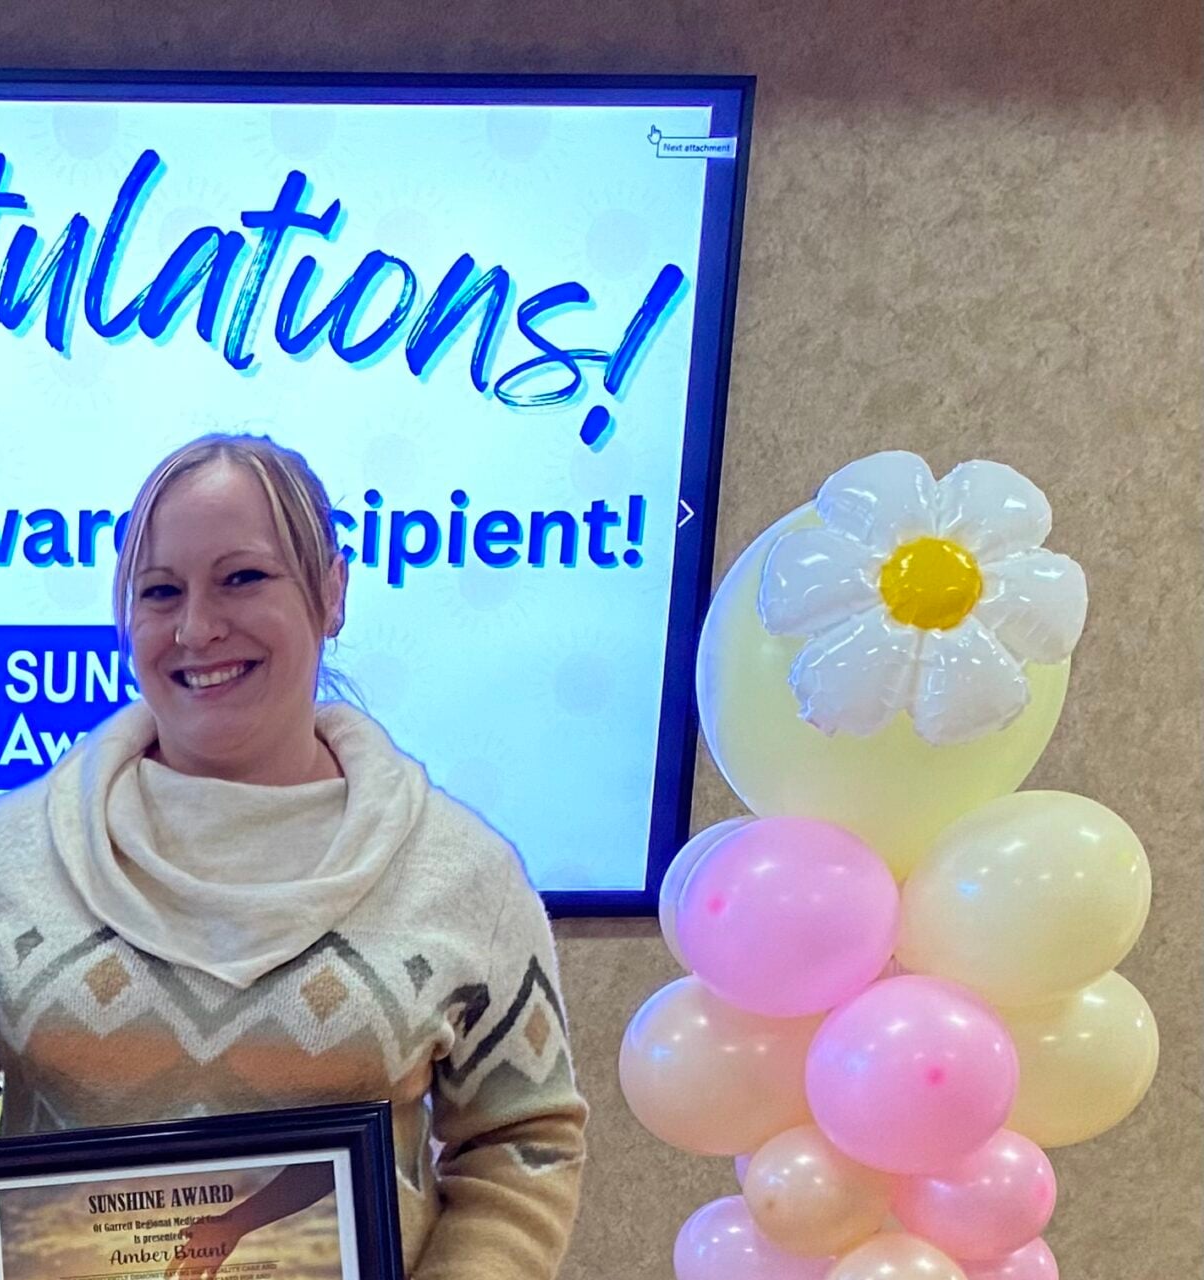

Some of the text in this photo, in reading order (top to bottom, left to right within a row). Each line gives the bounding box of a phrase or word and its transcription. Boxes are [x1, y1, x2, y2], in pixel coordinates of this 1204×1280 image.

[663, 143, 730, 152] Next attachment
[331, 488, 646, 588] cipient!
[88, 1184, 234, 1214] SUNSHINE AWARD
[109, 1249, 171, 1265] Amber
